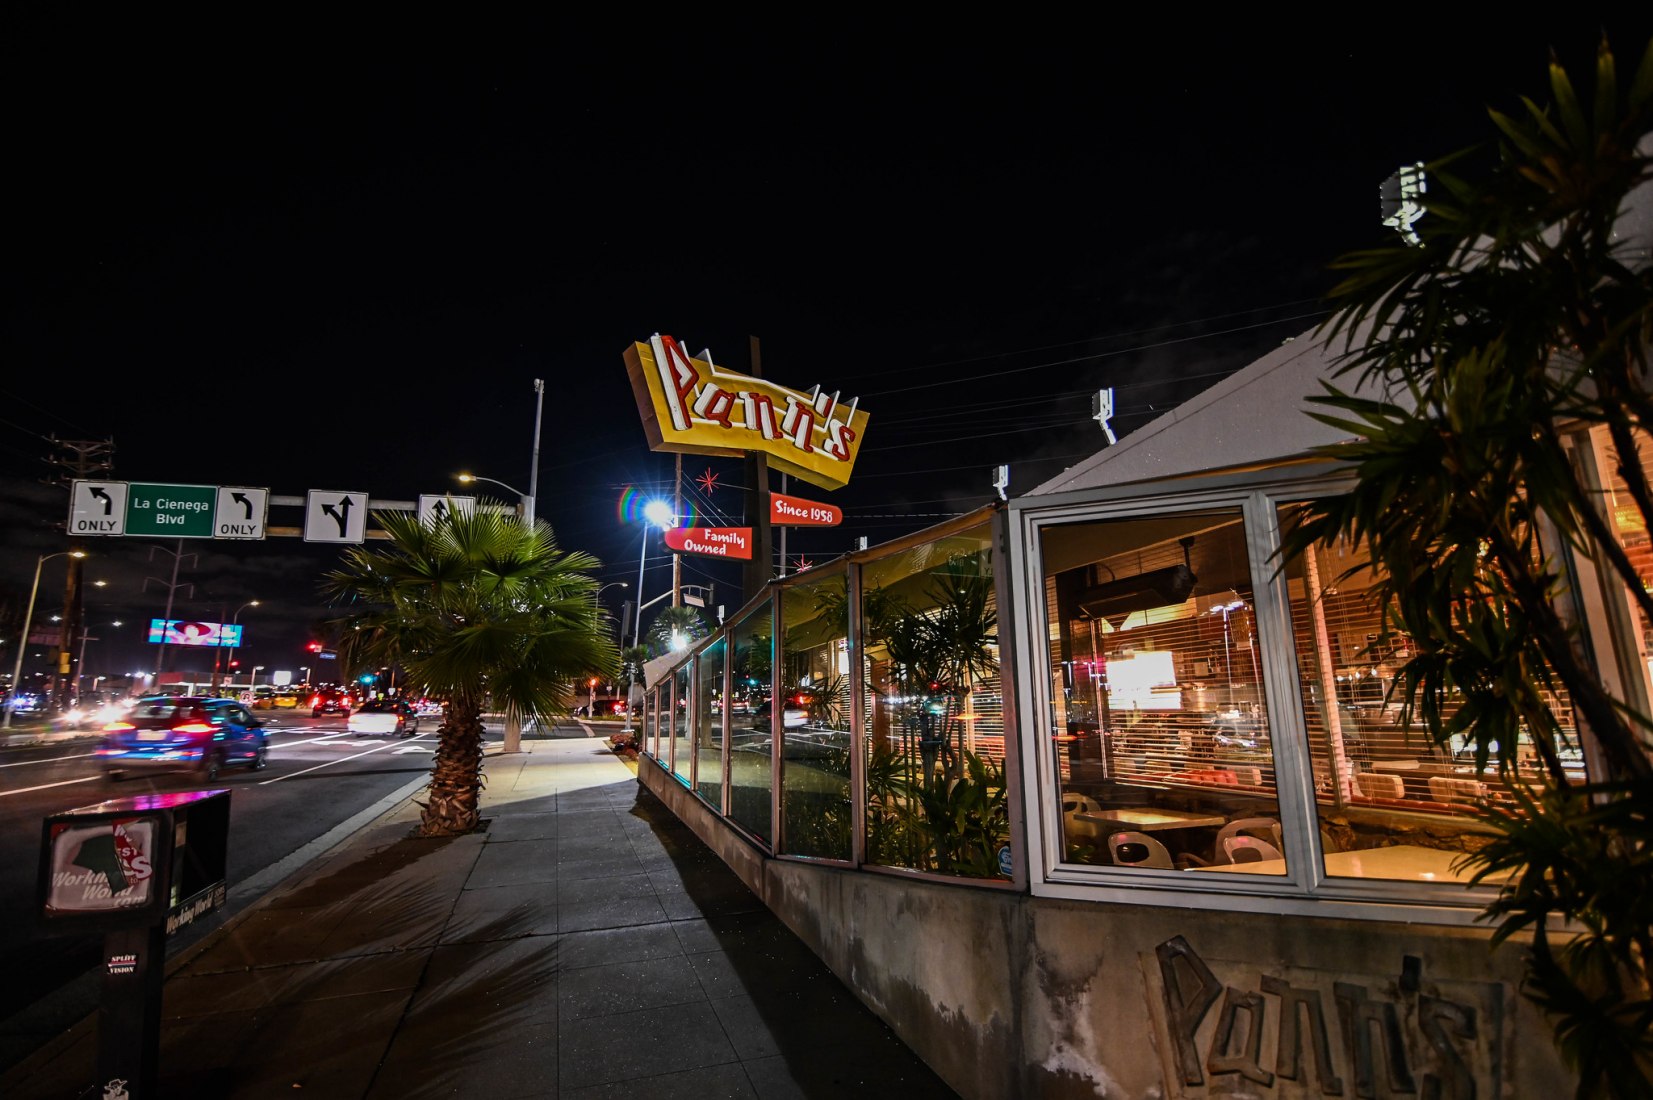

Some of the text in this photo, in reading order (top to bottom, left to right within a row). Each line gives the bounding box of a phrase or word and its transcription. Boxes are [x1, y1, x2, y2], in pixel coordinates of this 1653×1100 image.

[650, 332, 856, 462] Pann's
[134, 498, 209, 513] La Cienega
[775, 500, 833, 523] Since 1958
[77, 520, 117, 531] ONLY
[156, 514, 185, 525] Blvd
[221, 525, 256, 535] ONLY
[704, 529, 745, 548] Family
[684, 539, 727, 555] Owned
[1156, 934, 1477, 1100] Pann's
